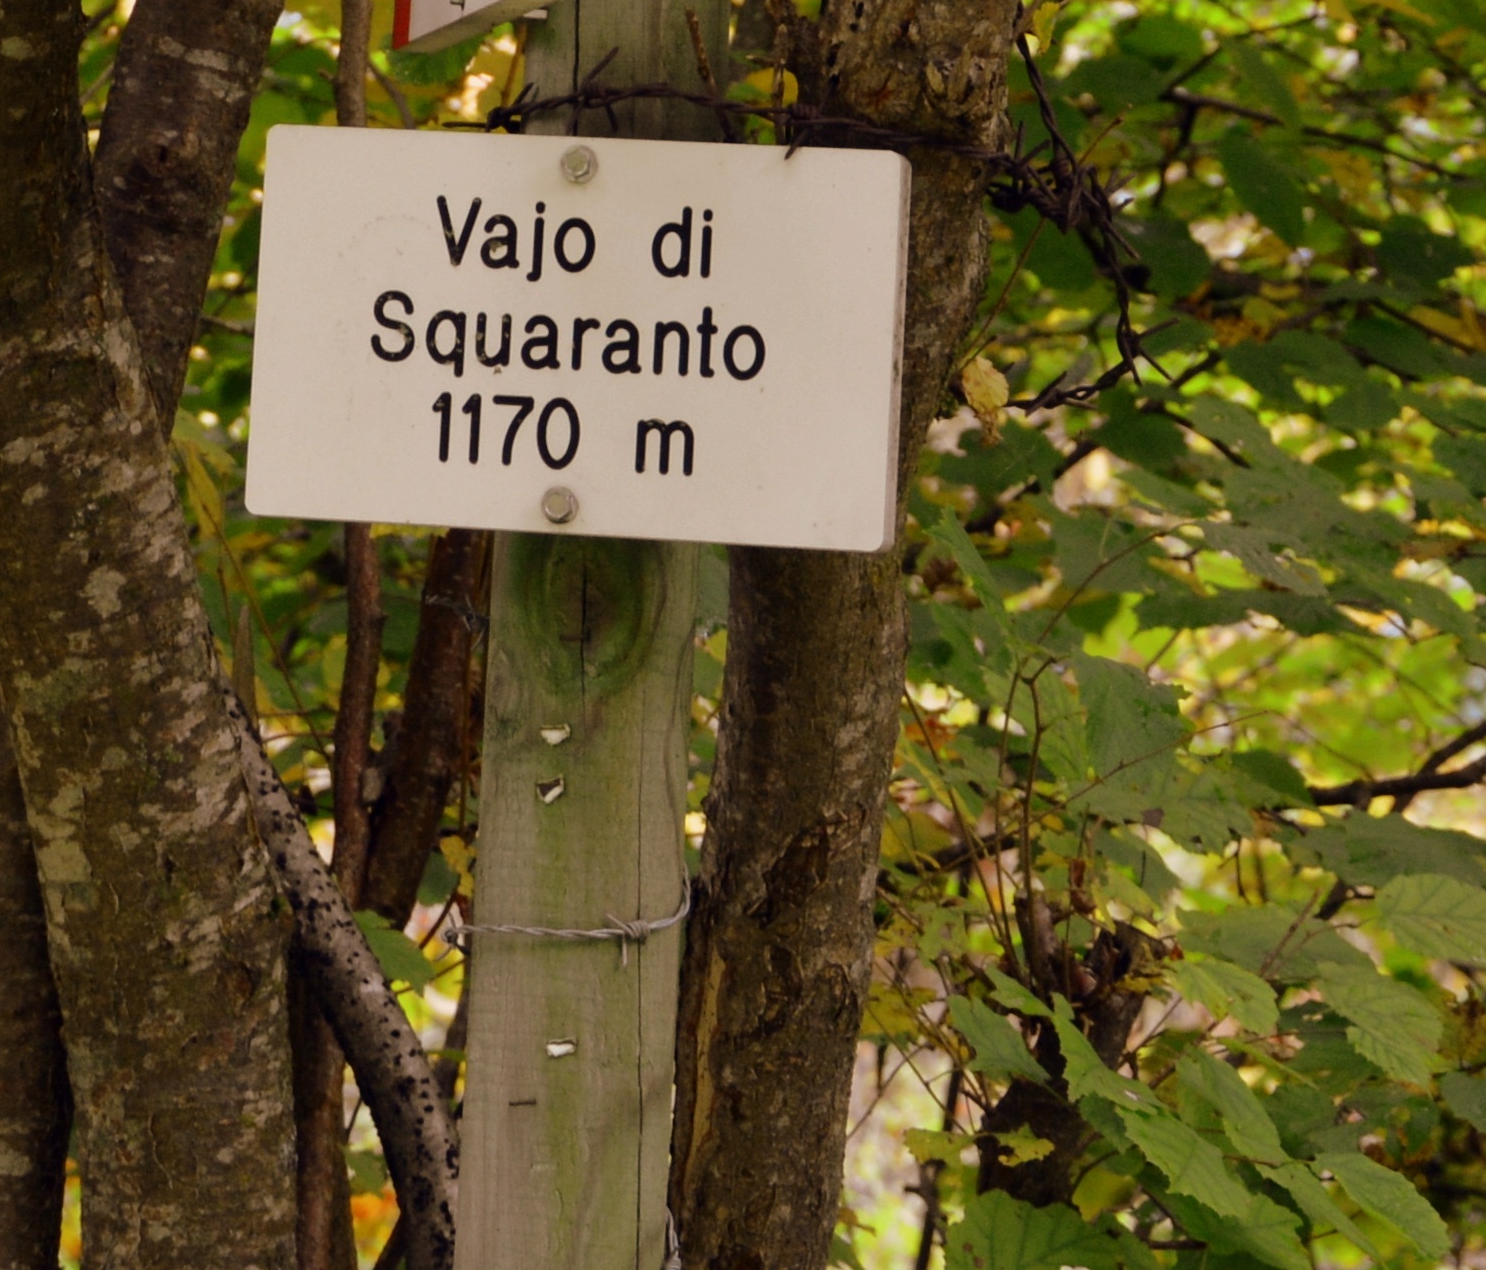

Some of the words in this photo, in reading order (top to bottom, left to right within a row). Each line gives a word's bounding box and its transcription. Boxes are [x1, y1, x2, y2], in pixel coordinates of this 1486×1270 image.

[437, 195, 596, 282] Vajo
[652, 207, 714, 279] di
[370, 290, 766, 381] Squaranto
[432, 392, 581, 470] 1170
[635, 418, 695, 476] m
